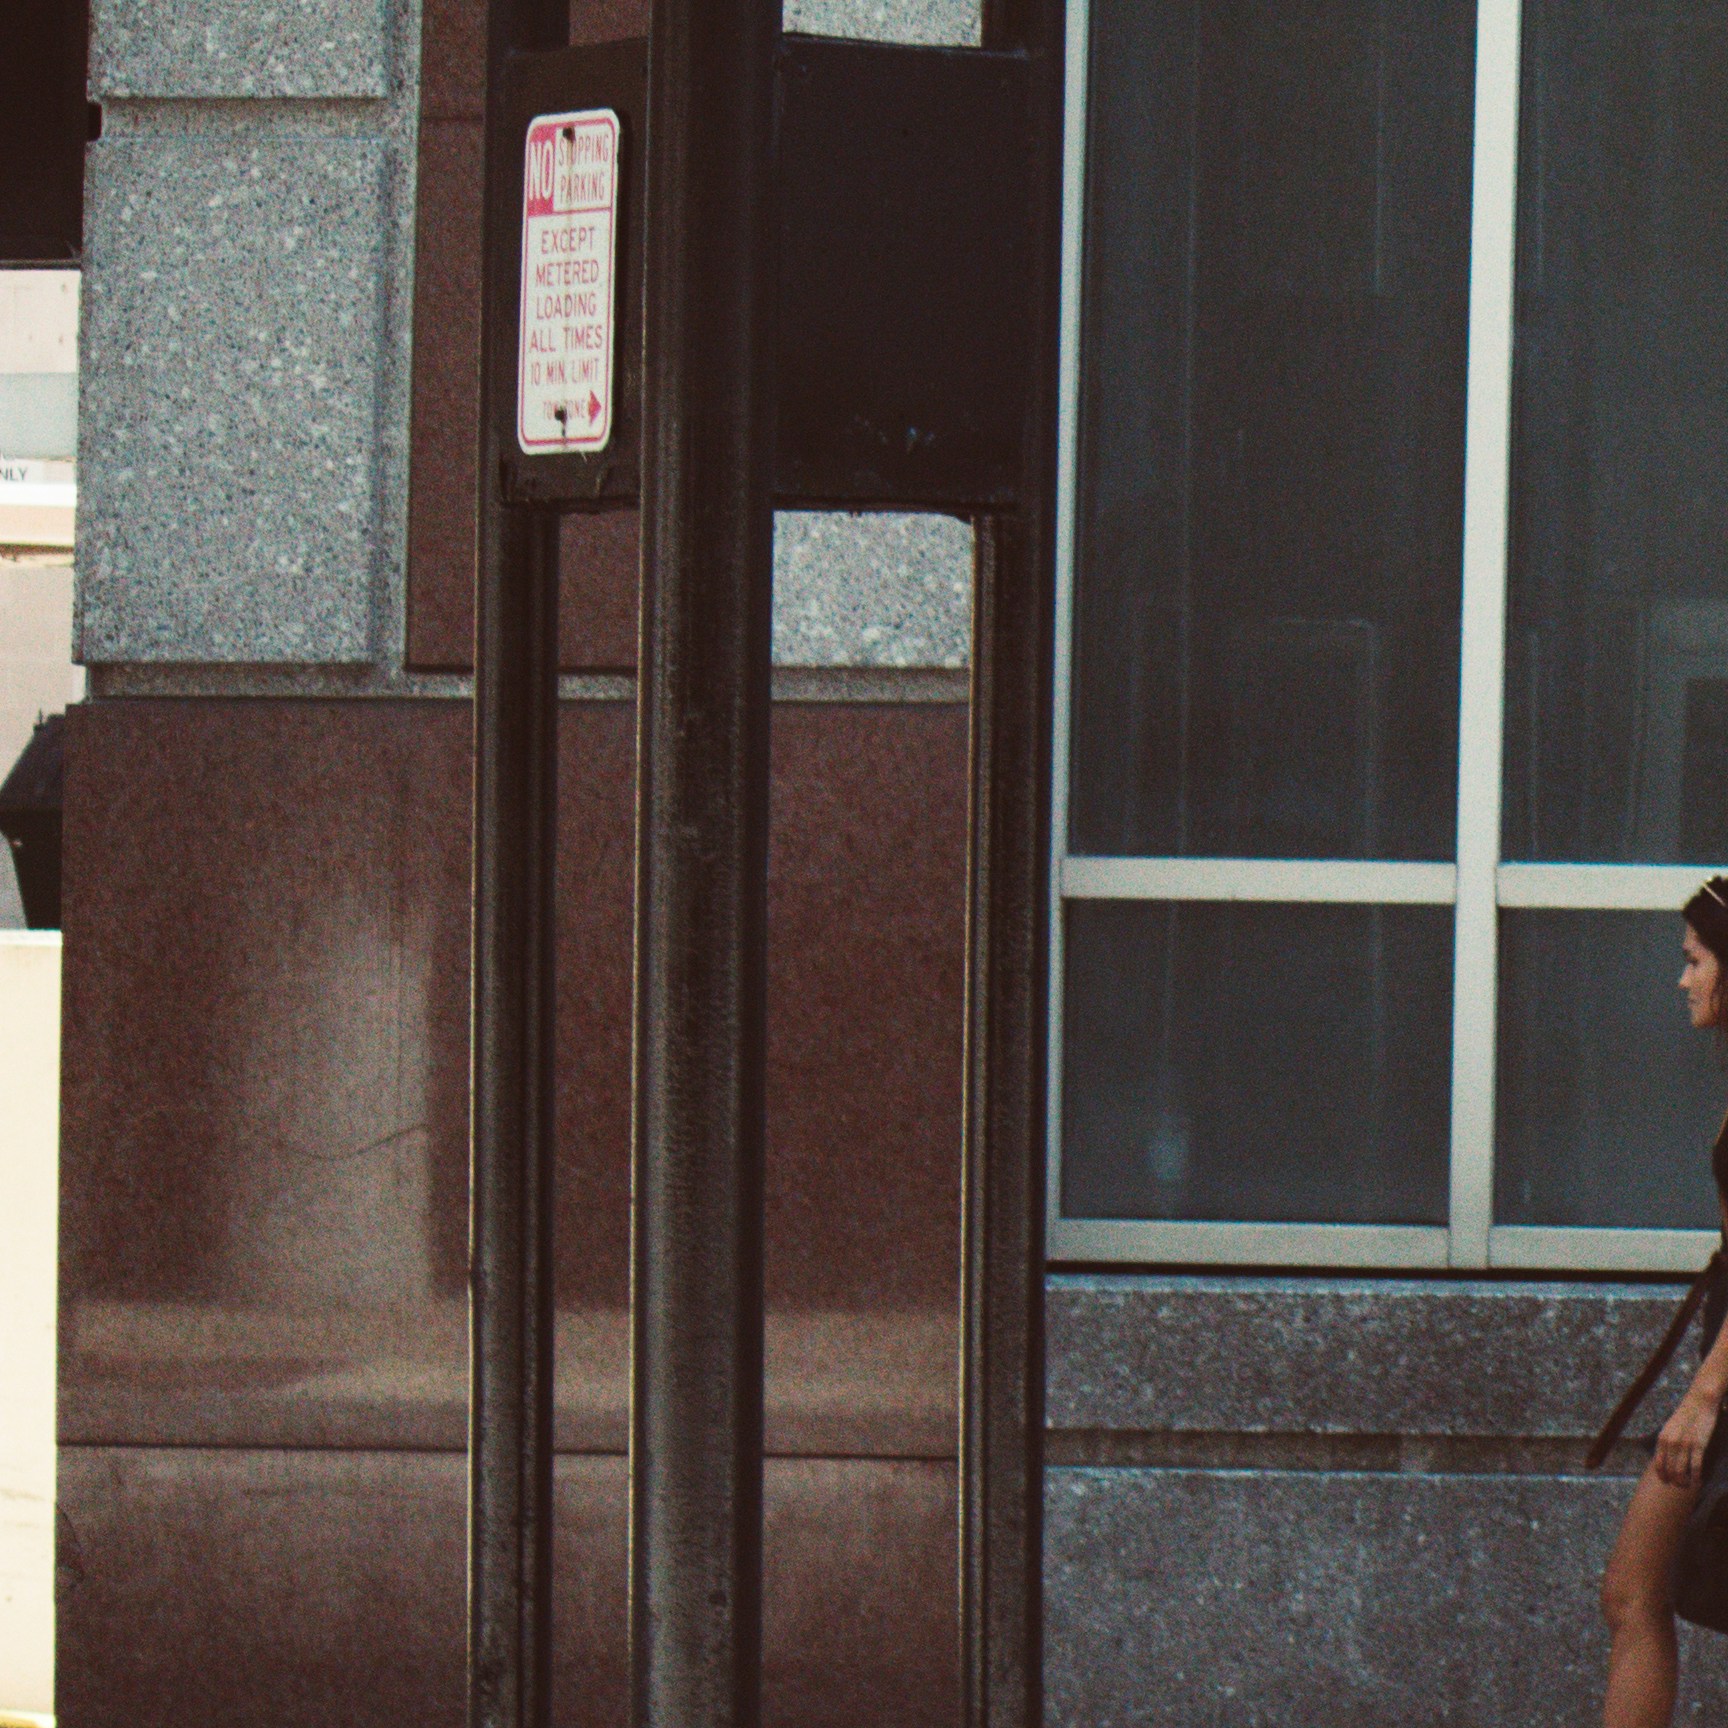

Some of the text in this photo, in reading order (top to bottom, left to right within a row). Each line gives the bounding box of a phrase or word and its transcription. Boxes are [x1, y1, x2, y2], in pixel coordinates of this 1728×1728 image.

[528, 139, 554, 200] NO
[560, 171, 605, 203] PARKING
[541, 226, 595, 255] EXCEPT
[536, 259, 600, 288] METERED
[536, 291, 597, 320] LOADING
[529, 323, 603, 354] ALL TIMES
[531, 361, 541, 386] 10
[571, 358, 600, 383] LIMIT
